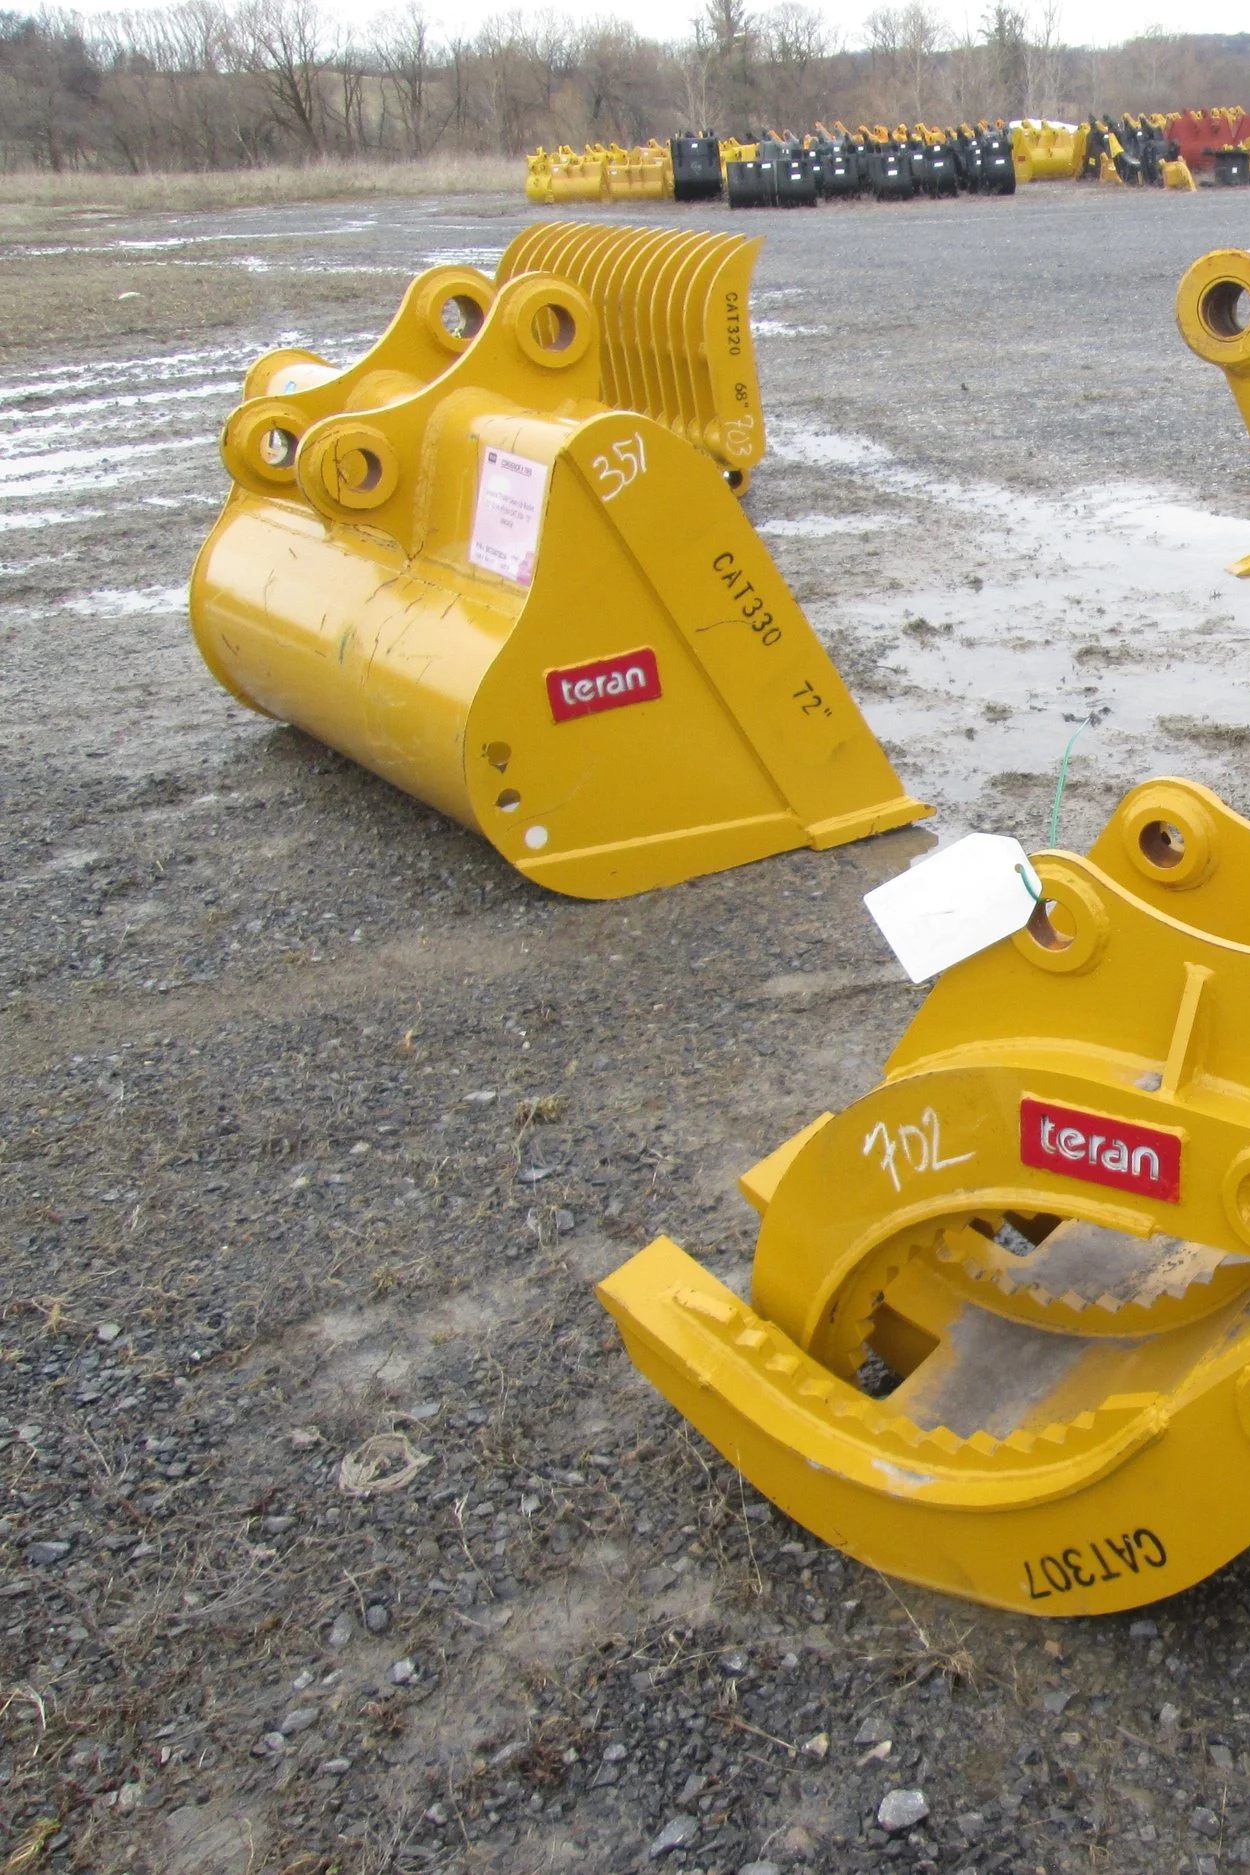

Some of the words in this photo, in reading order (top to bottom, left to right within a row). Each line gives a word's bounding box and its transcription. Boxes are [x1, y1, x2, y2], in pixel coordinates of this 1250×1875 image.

[725, 291, 741, 356] CAT320
[592, 431, 648, 502] 351
[724, 414, 754, 456] 703
[712, 551, 783, 647] CAT330
[560, 664, 647, 706] teran
[863, 1106, 976, 1192] 702
[1039, 1114, 1160, 1180] teran
[1023, 1528, 1167, 1599] CAT307
